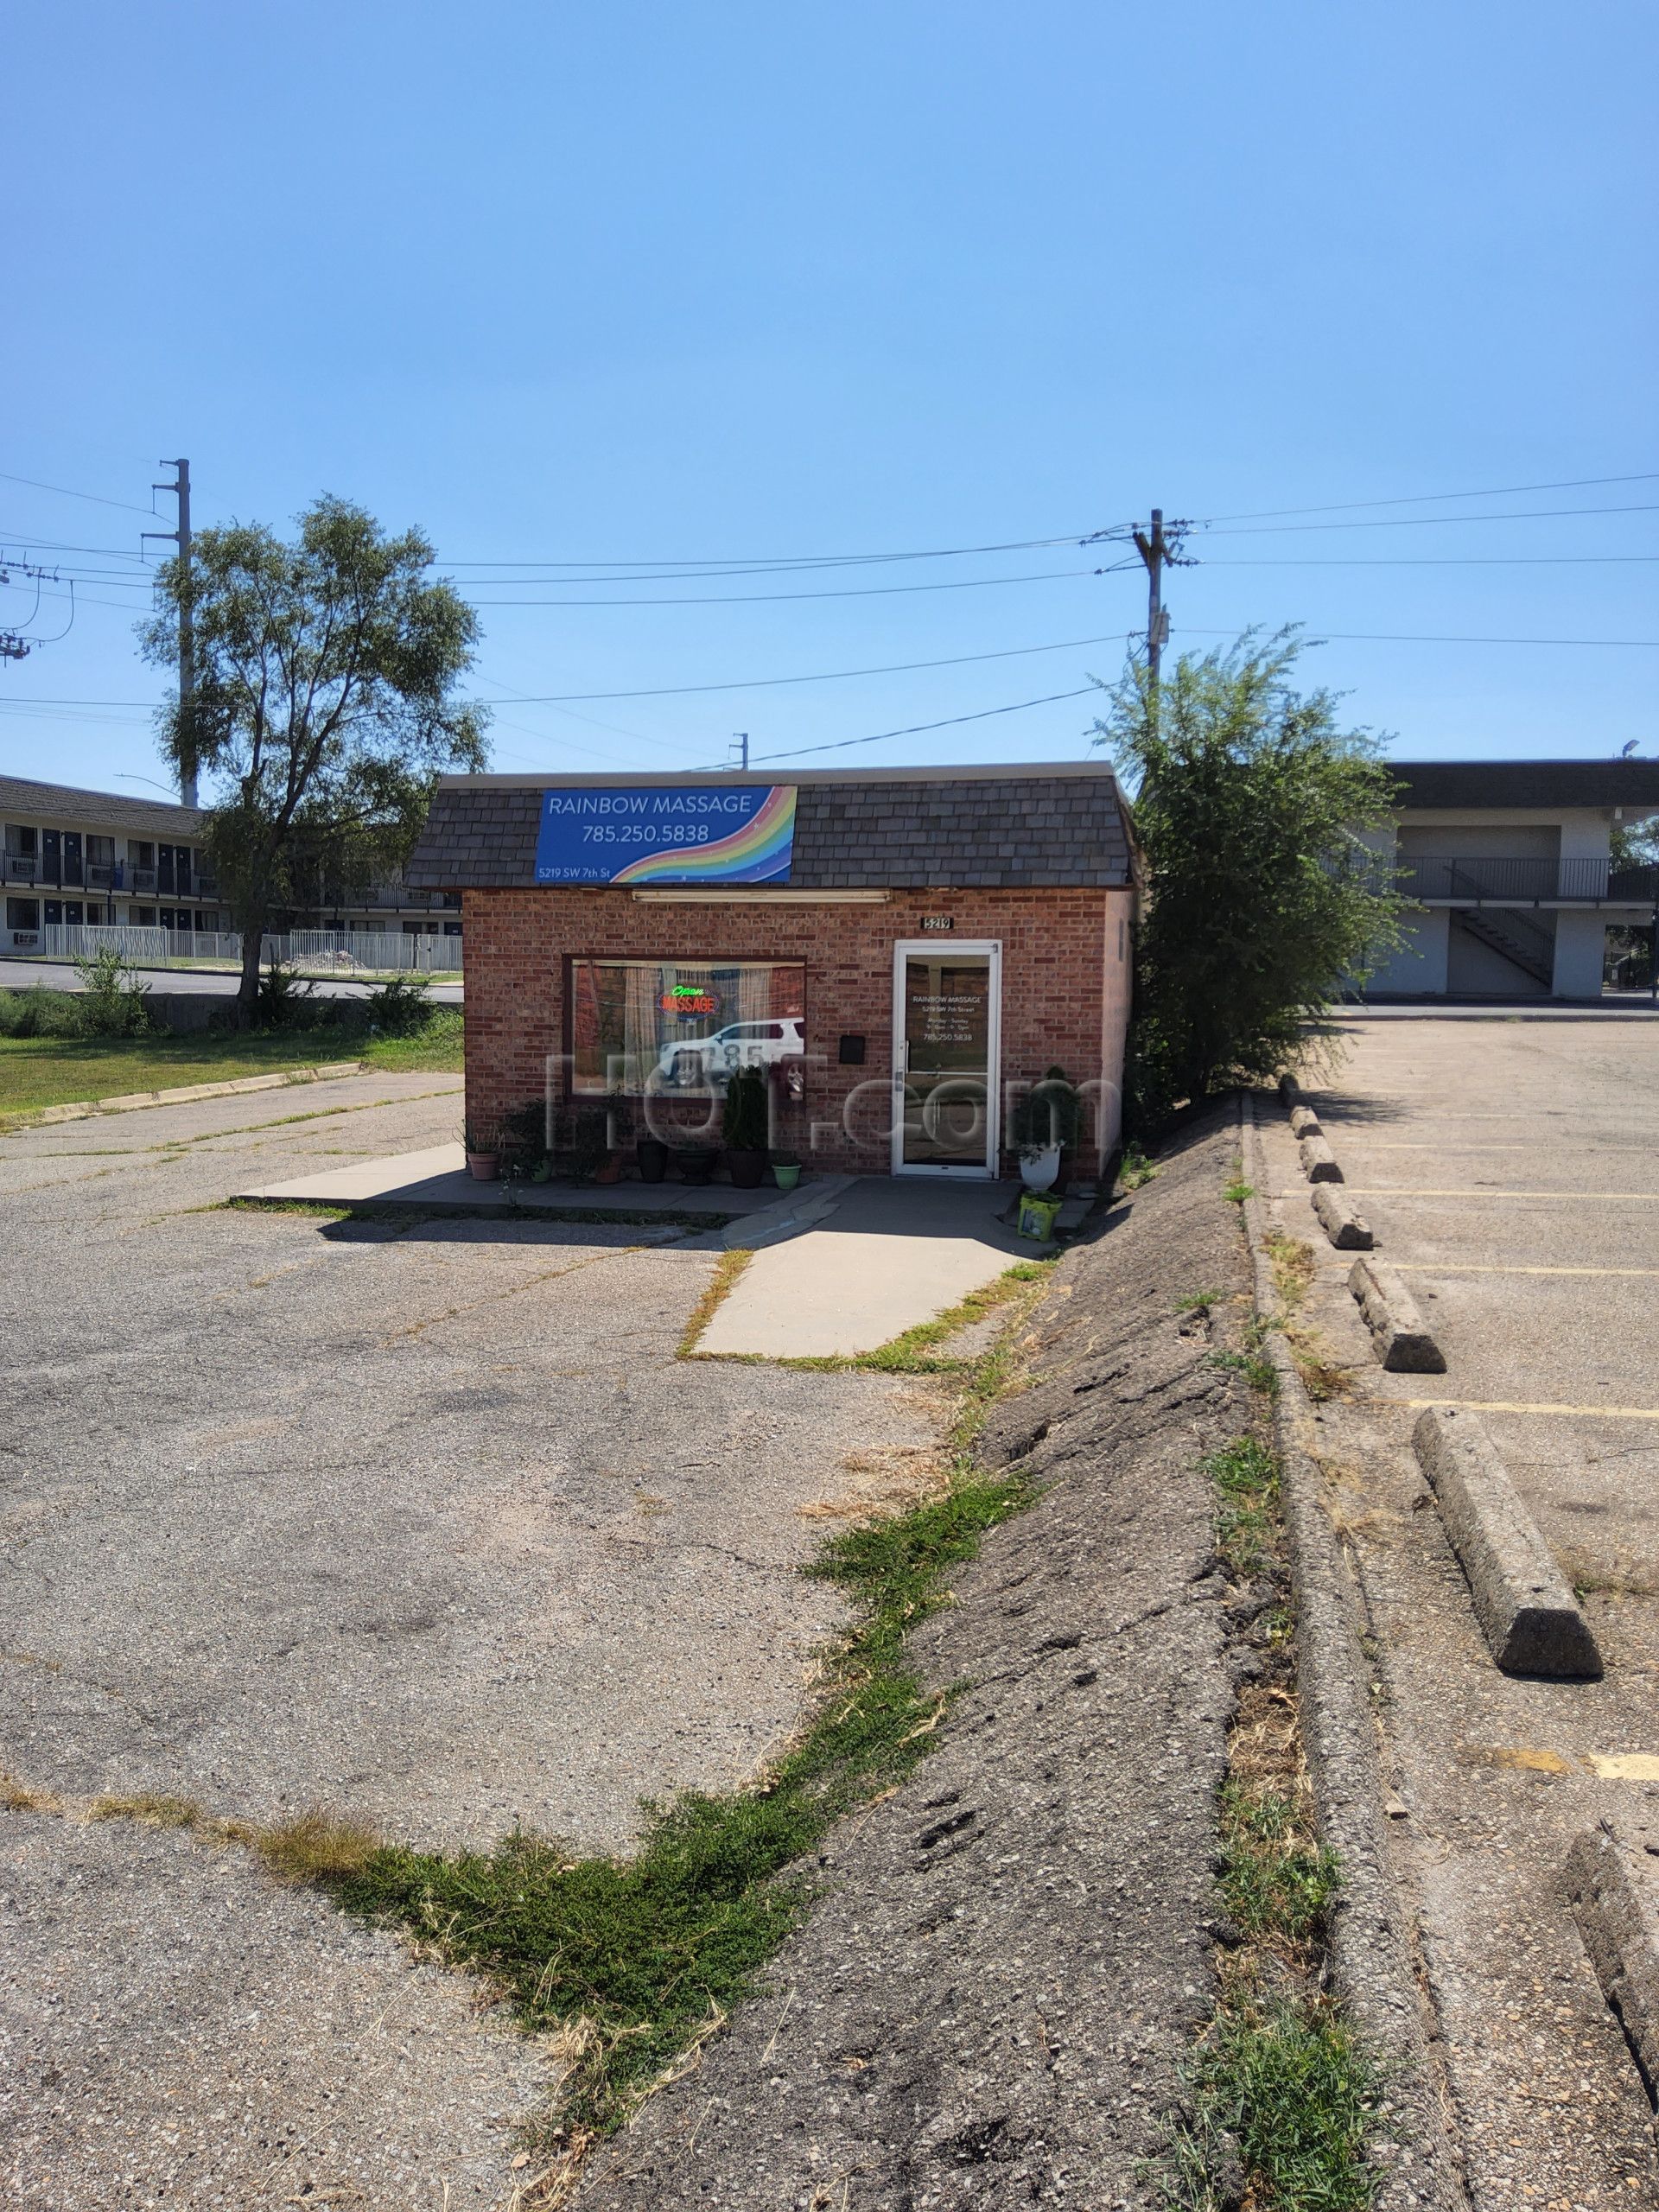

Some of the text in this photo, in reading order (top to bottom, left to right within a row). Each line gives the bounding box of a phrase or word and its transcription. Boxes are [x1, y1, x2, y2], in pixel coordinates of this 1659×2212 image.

[549, 794, 753, 815] RAINBOW MASSAGE
[582, 825, 709, 842] 785.250.5838
[538, 868, 610, 878] 5219 SW 7th St
[925, 918, 949, 928] 5219
[671, 986, 704, 997] Open
[663, 995, 715, 1013] MASSAGE
